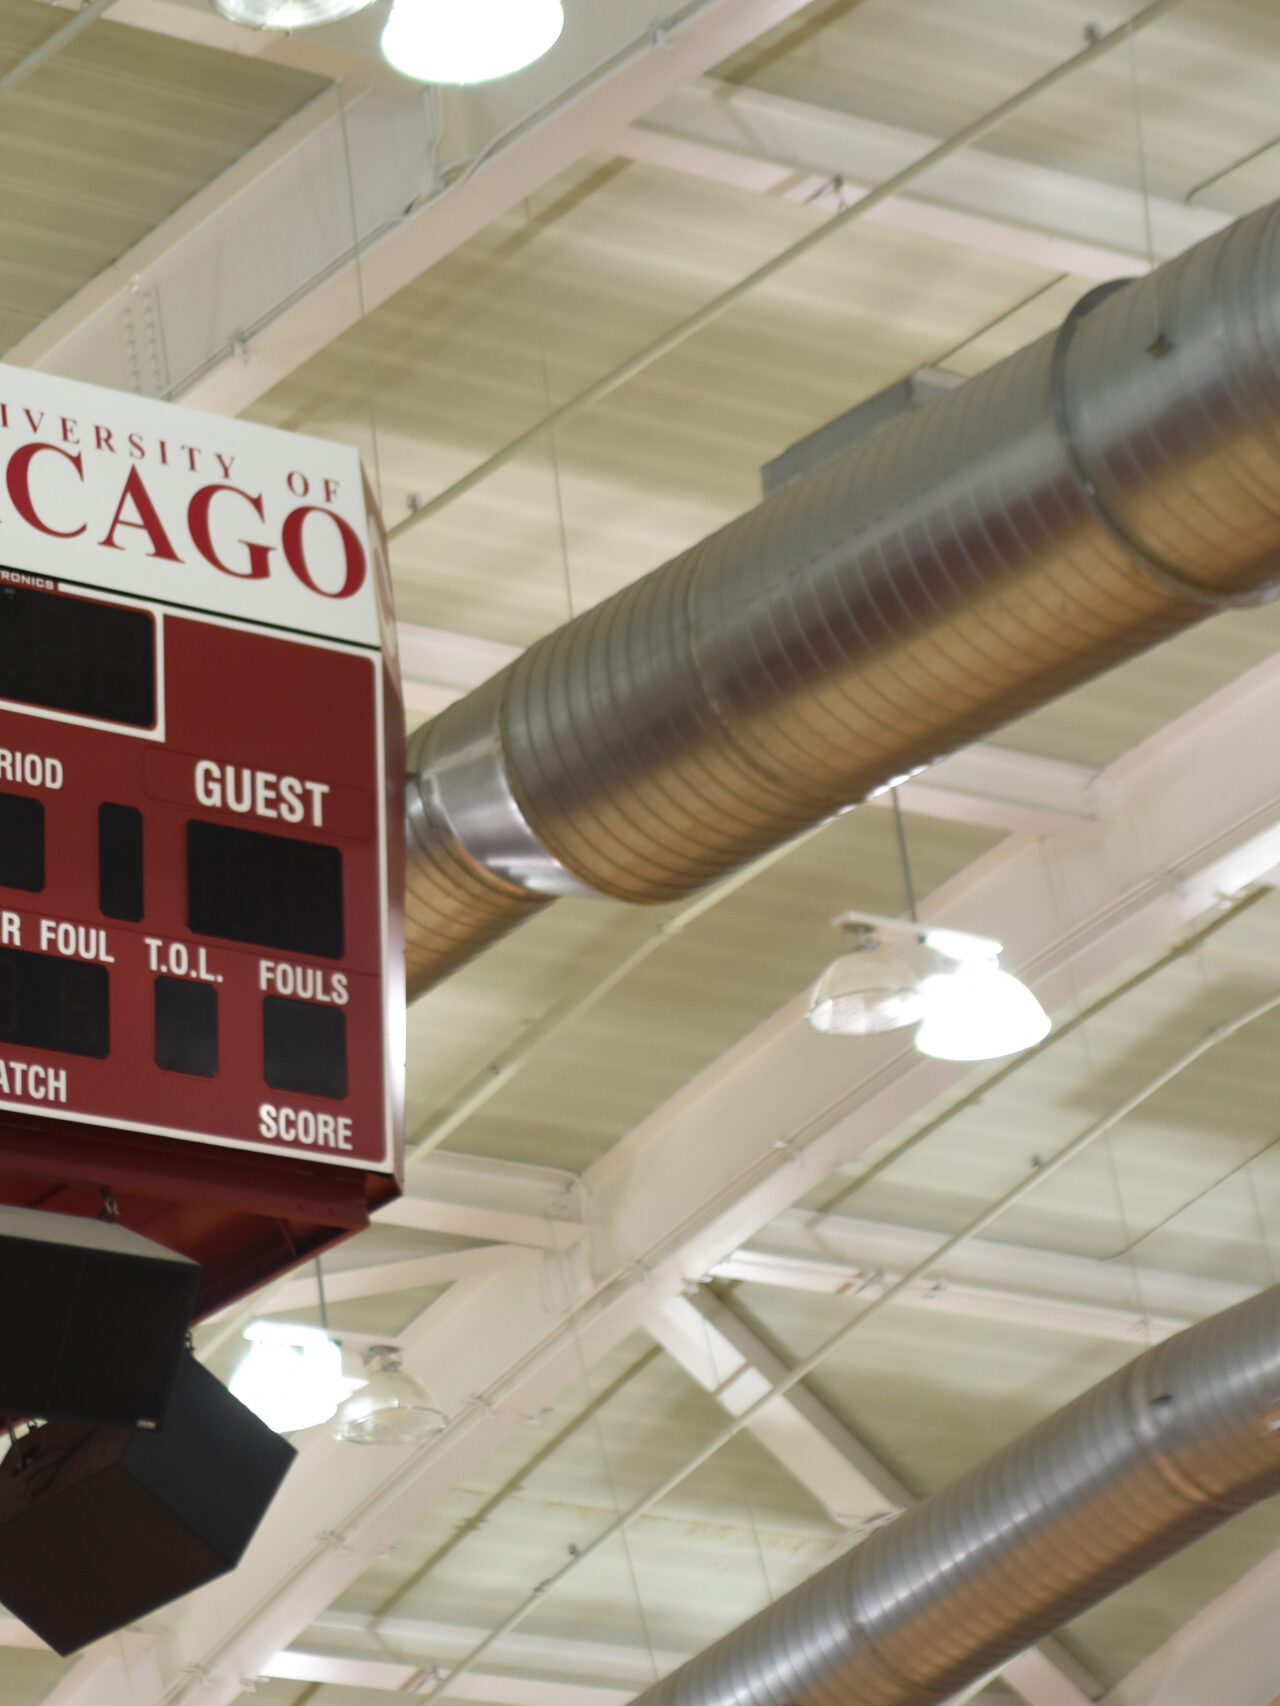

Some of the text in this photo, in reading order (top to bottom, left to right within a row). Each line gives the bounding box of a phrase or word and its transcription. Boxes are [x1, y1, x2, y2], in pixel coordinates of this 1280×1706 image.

[286, 471, 340, 503] OF
[194, 760, 329, 827] GUEST
[40, 919, 115, 963] FOUL
[144, 937, 223, 982] T.O.L.
[259, 960, 349, 1004] FOULS
[259, 1104, 353, 1151] SCORE
